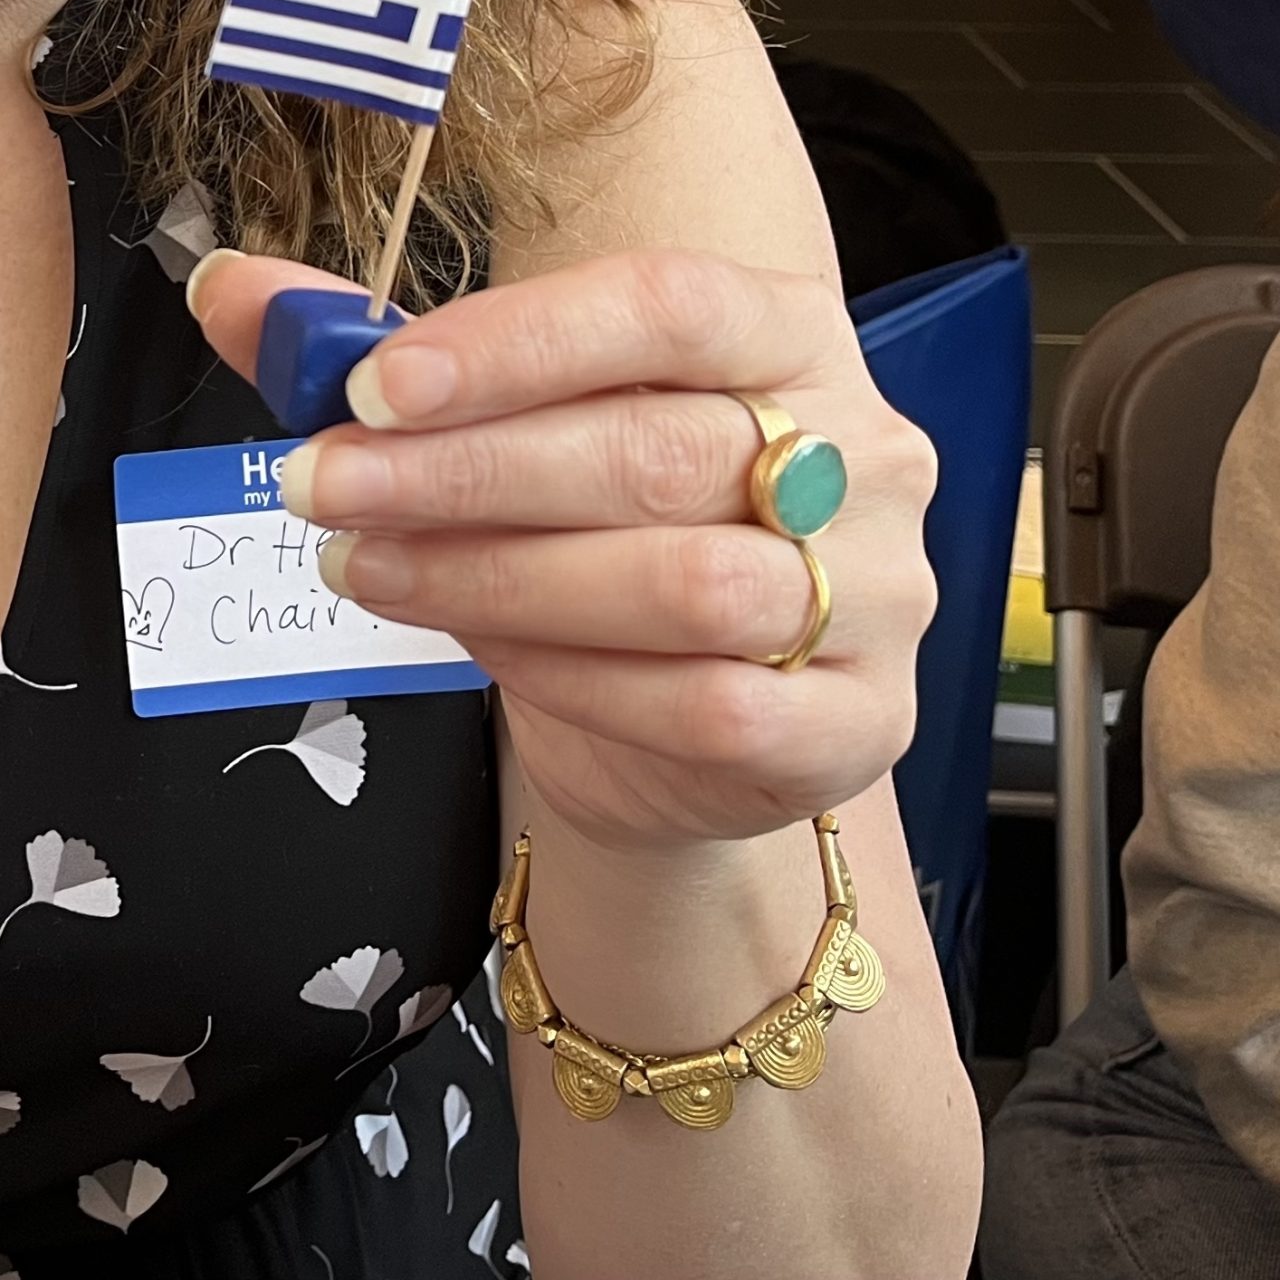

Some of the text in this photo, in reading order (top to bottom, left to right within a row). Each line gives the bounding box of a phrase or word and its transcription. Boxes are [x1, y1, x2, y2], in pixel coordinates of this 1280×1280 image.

[244, 490, 271, 507] my
[179, 524, 255, 570] Dr
[211, 588, 380, 645] Chair
